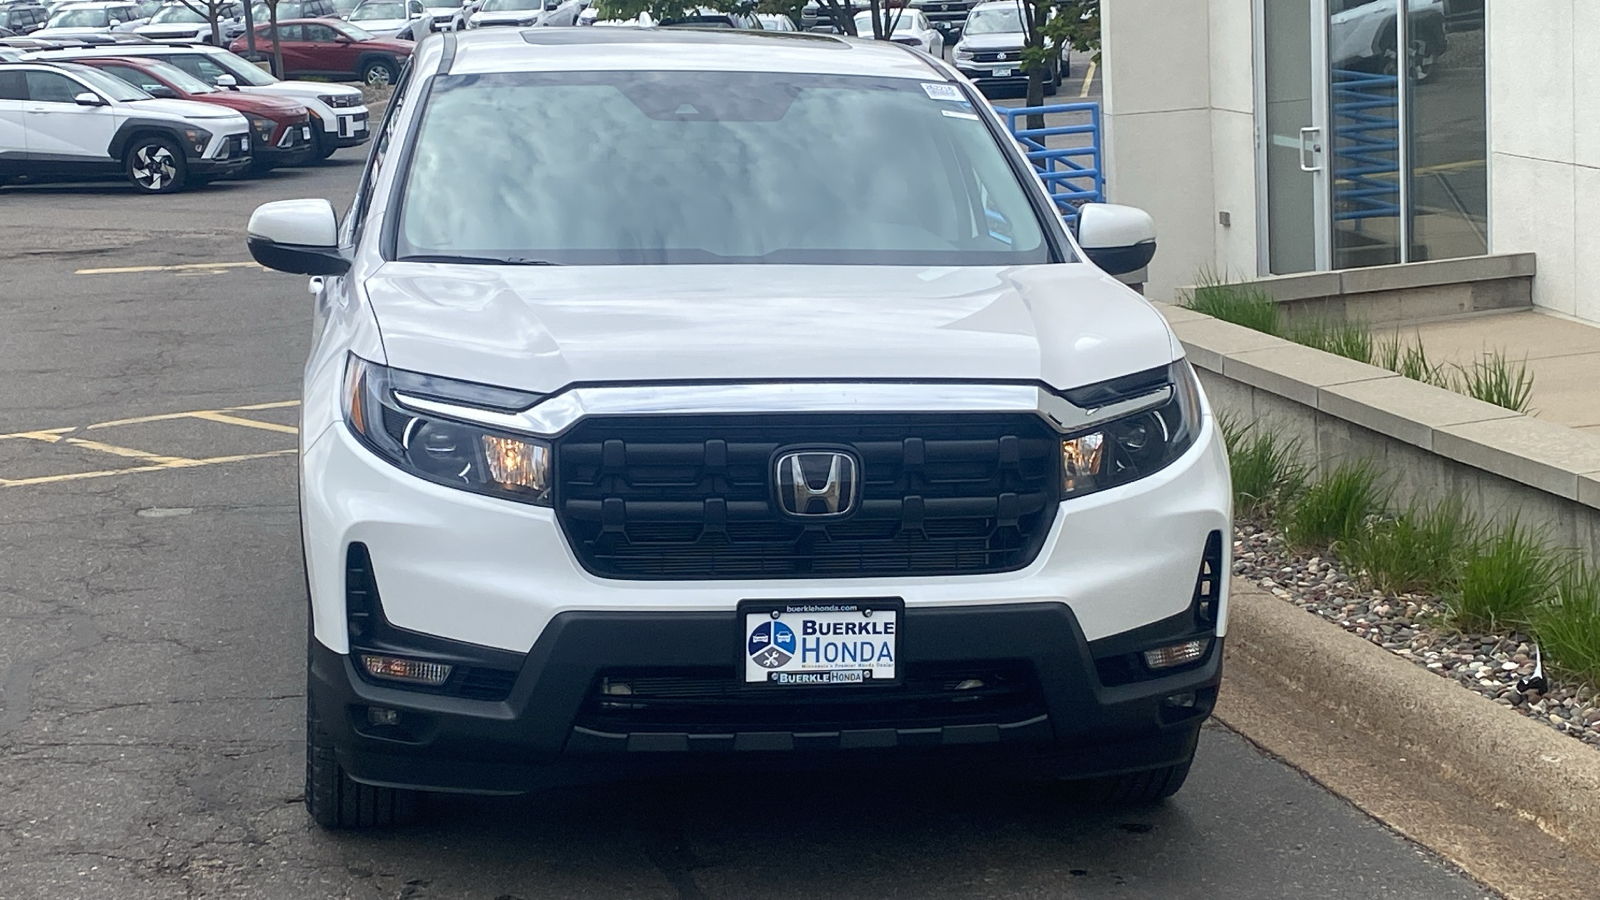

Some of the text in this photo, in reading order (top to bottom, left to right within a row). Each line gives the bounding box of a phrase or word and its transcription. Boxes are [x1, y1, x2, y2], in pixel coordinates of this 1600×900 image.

[786, 605, 858, 613] buerklehonda.com
[802, 620, 895, 636] BUERKLE
[801, 637, 894, 663] HONDA
[780, 672, 861, 683] BUERKLE HONDA
